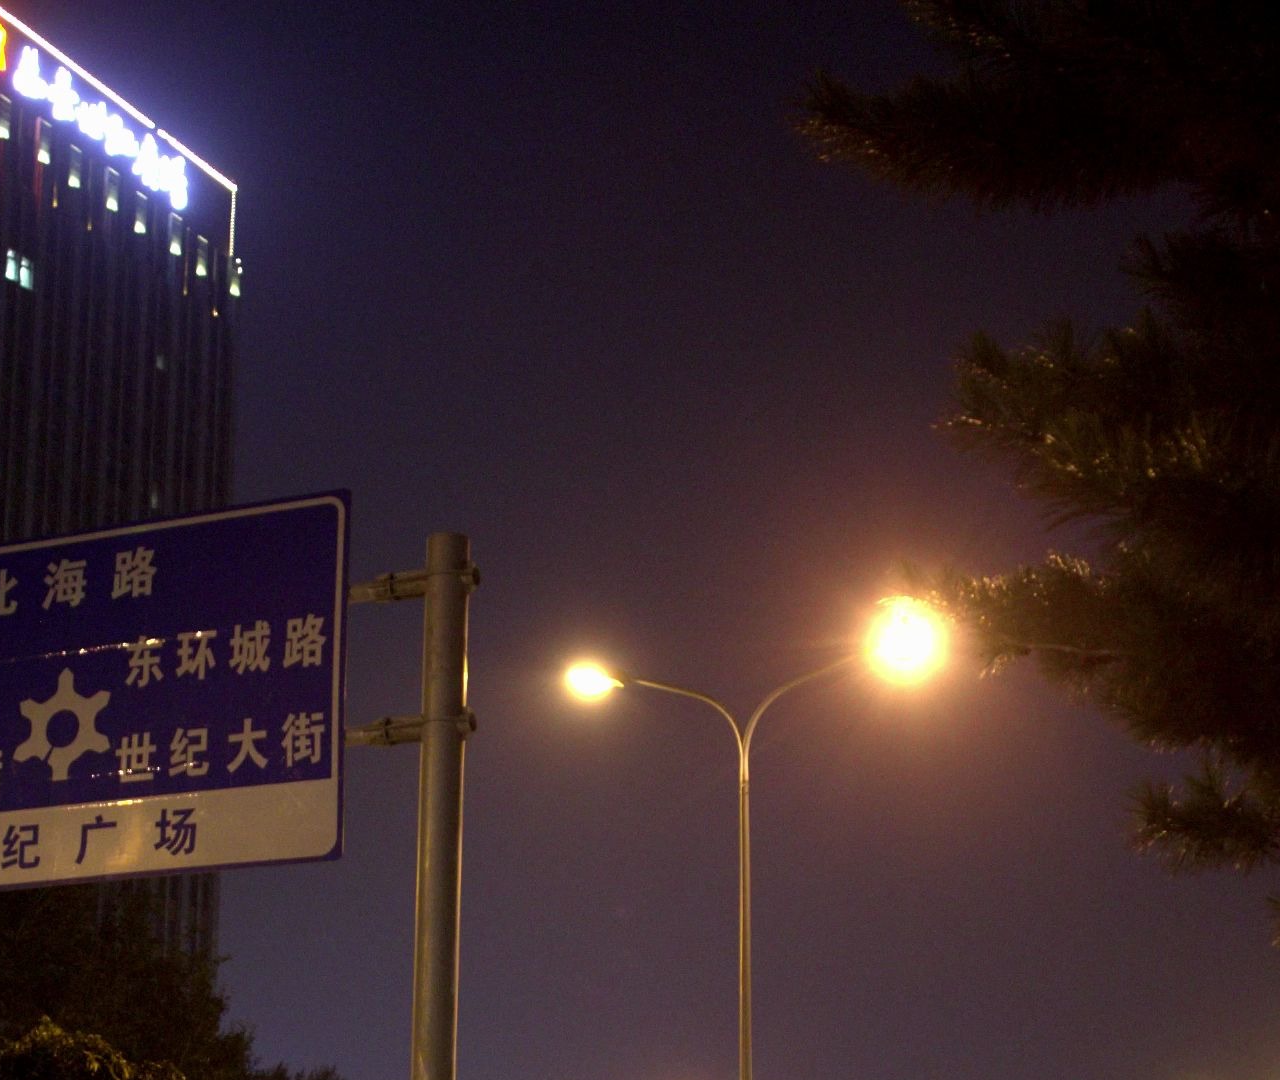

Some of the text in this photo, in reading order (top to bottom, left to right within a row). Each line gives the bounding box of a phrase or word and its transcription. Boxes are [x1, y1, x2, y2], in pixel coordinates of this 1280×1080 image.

[125, 614, 327, 687] 东环城路
[115, 712, 326, 783] 世纪大街
